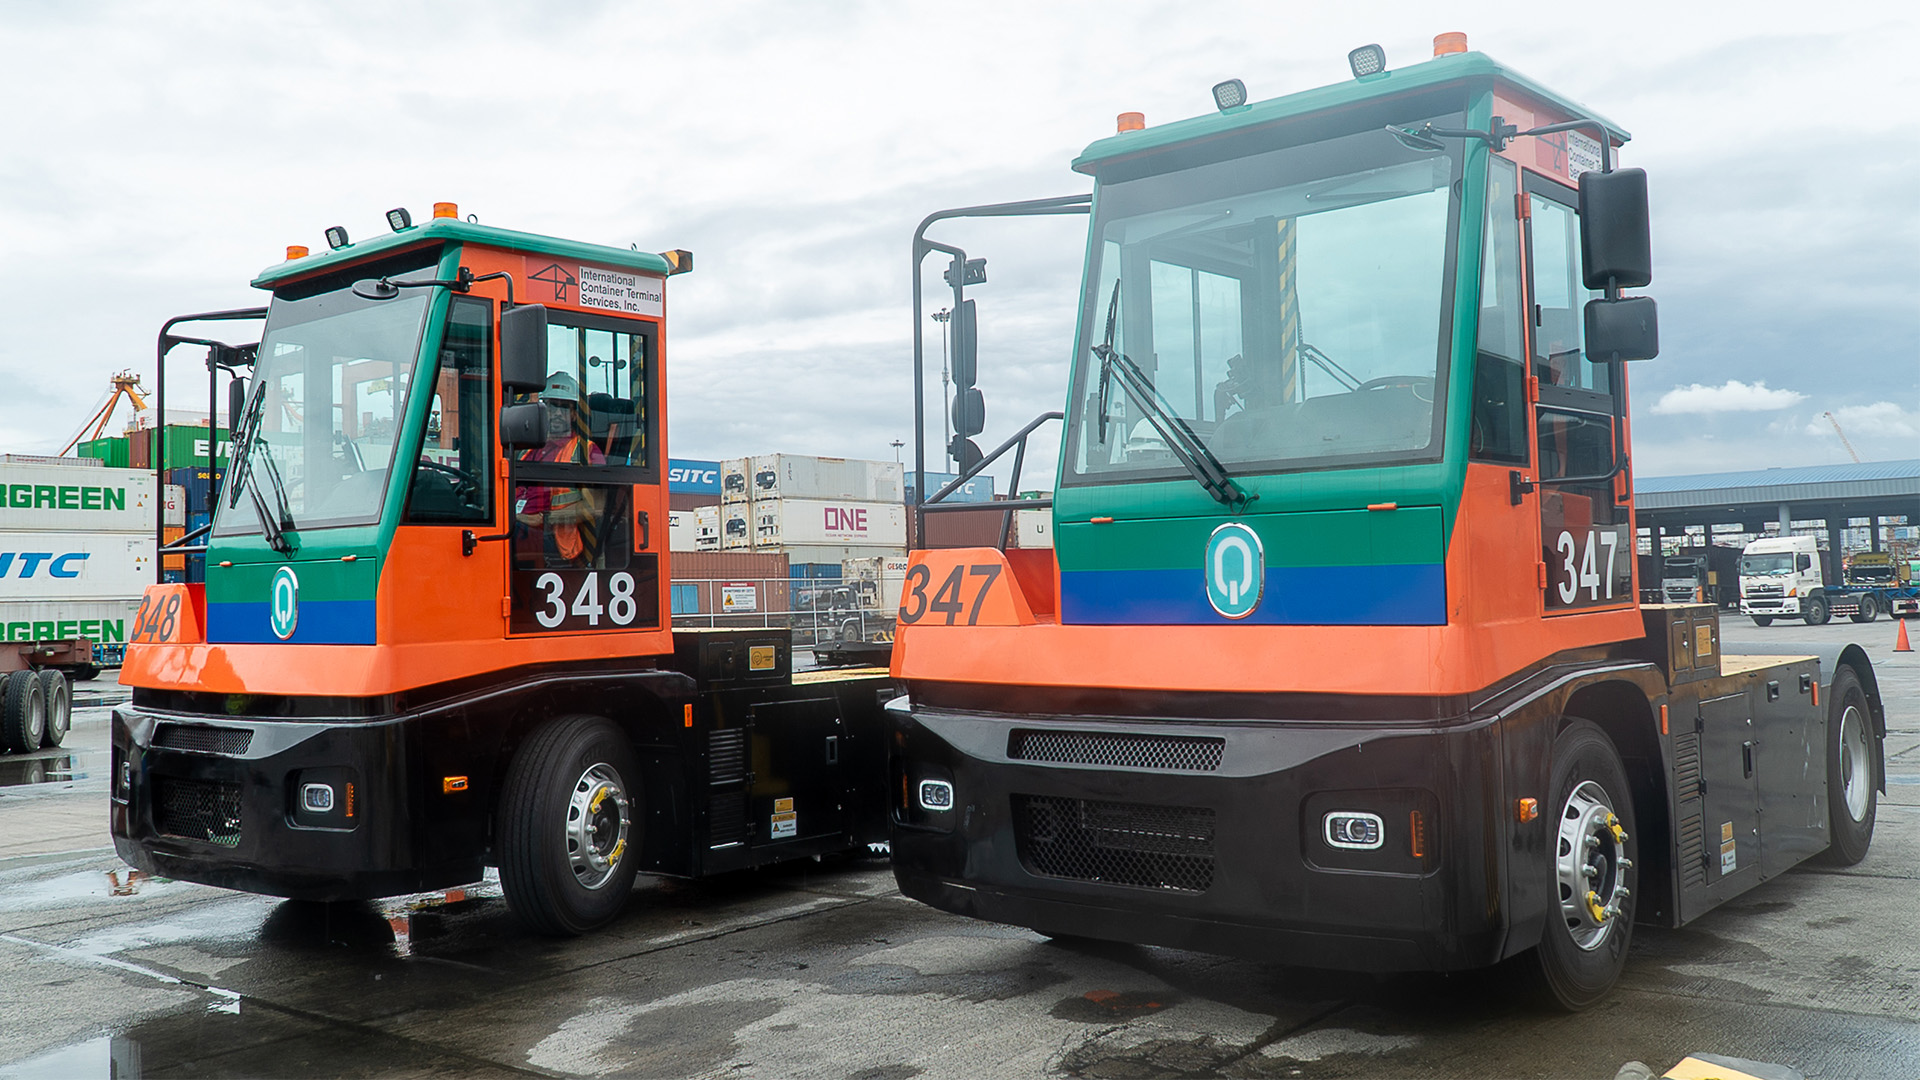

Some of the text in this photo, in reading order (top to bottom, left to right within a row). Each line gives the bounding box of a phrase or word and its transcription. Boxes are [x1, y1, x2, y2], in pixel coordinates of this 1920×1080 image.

[581, 268, 635, 287] International
[581, 281, 661, 302] Container Terminal
[581, 294, 640, 312] Services, Inc.
[198, 472, 221, 480] seao
[668, 468, 717, 484] SITC
[824, 507, 868, 531] ONE
[1557, 530, 1618, 605] 347
[536, 572, 637, 628] 348
[900, 563, 1002, 626] 347
[132, 593, 181, 642] 348
[0, 619, 124, 643] GREEN
